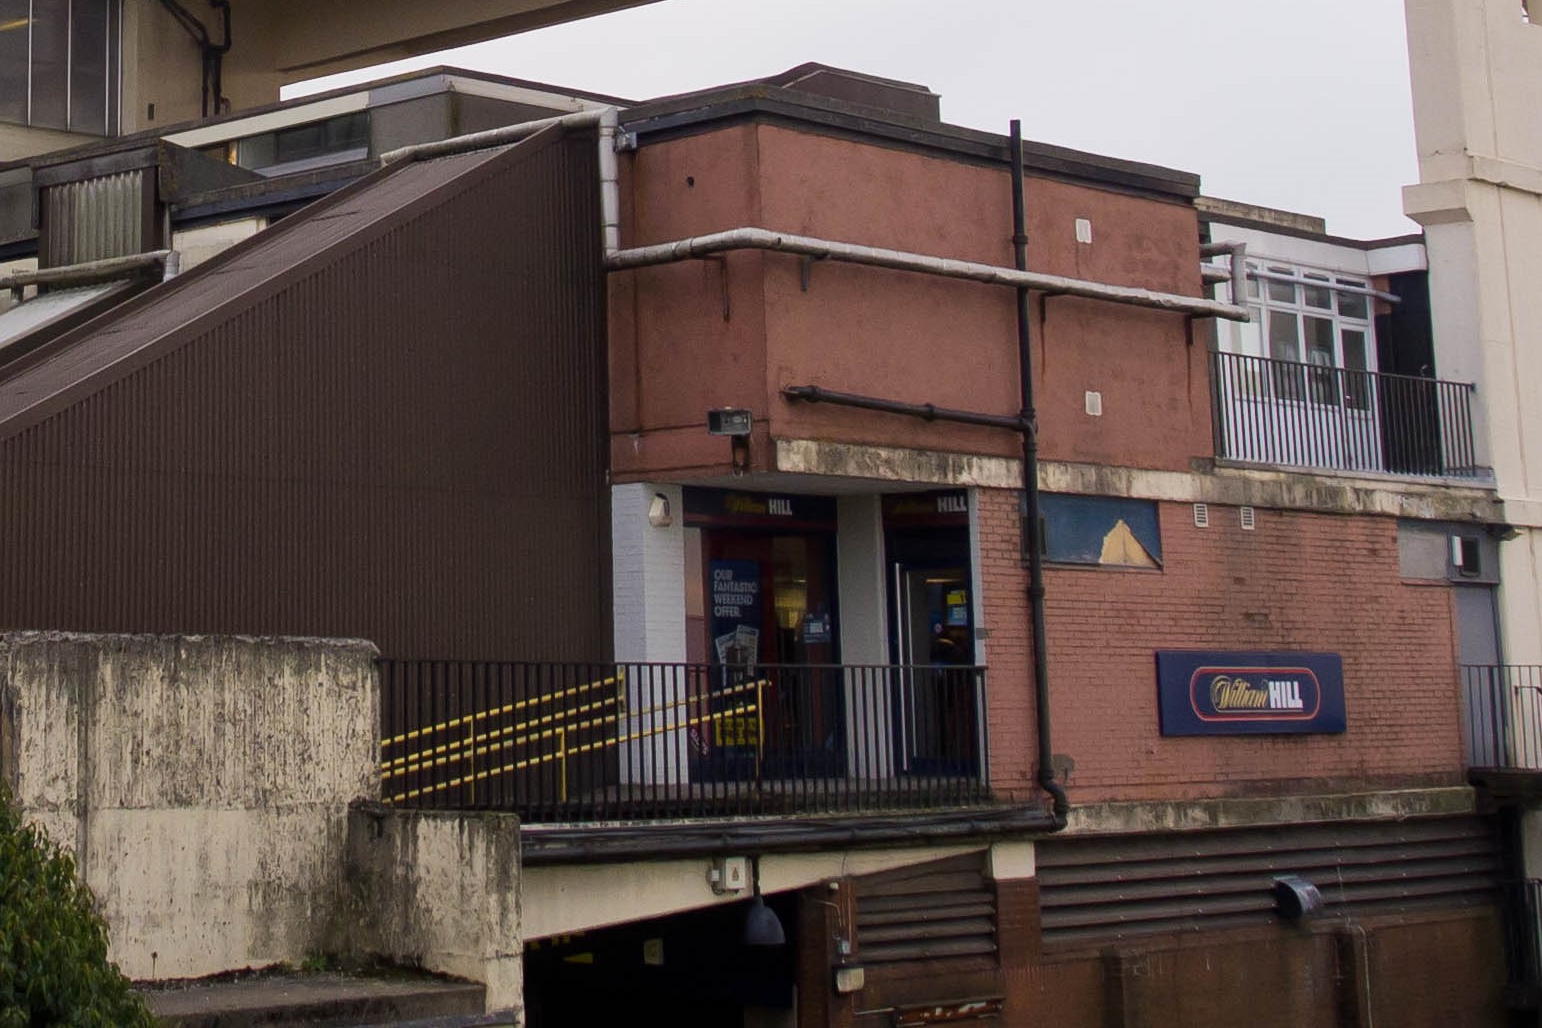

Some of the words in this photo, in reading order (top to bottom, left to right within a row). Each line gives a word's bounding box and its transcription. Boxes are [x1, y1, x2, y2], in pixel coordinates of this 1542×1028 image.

[768, 499, 793, 516] HILL
[937, 495, 968, 513] HILL
[713, 569, 734, 581] OUR
[713, 581, 759, 593] FANTASTIC
[713, 593, 754, 605] WEEKEND
[1210, 675, 1269, 710] William
[1268, 680, 1304, 709] HILL
